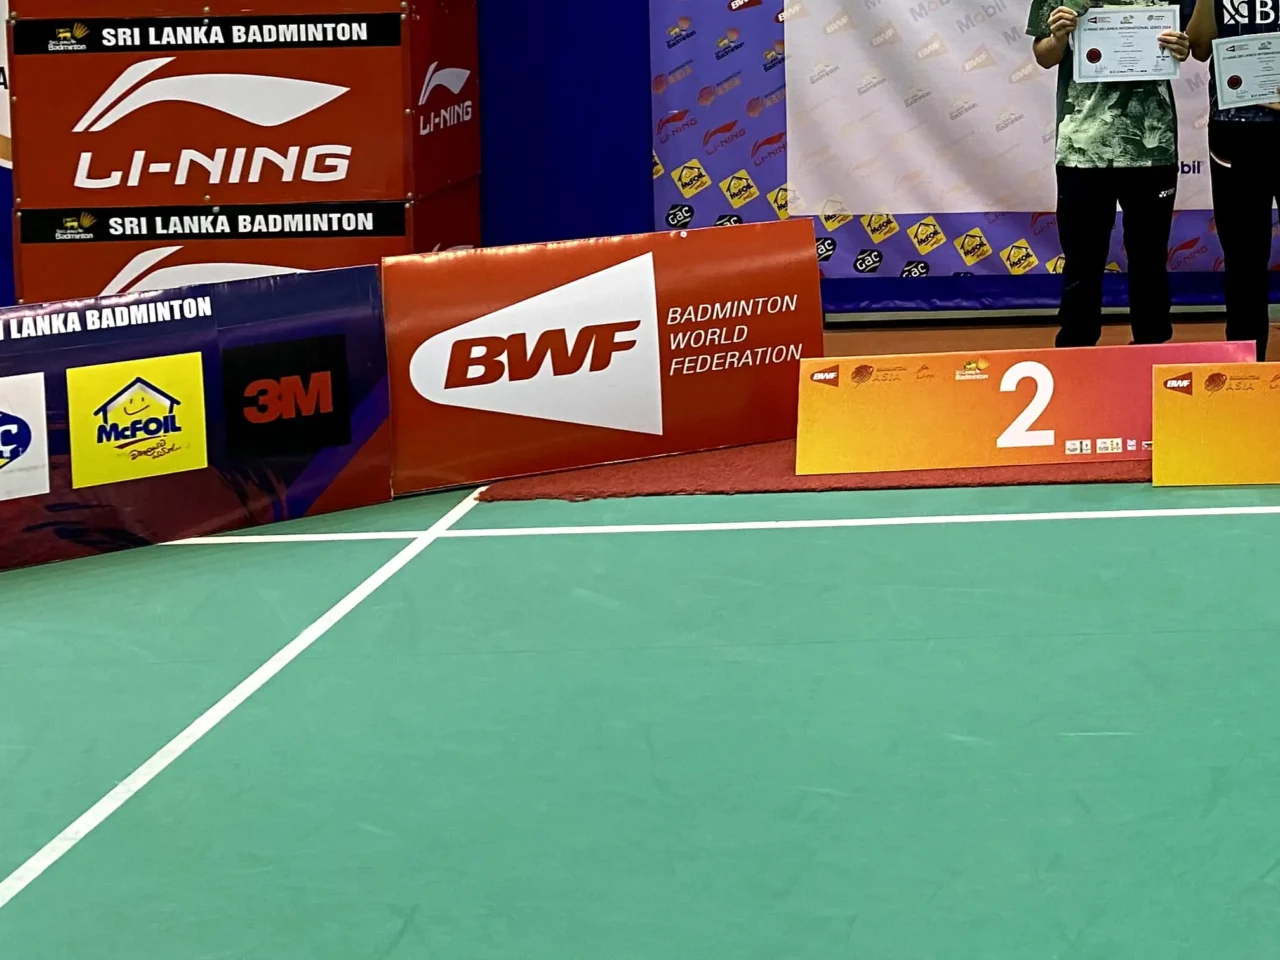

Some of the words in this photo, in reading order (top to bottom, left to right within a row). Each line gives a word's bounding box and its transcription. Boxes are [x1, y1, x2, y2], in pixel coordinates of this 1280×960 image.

[102, 27, 141, 47] SRI
[149, 25, 224, 45] LANKA
[232, 23, 367, 43] BADMINTON
[419, 100, 472, 136] LI-NING
[74, 144, 352, 189] LI-NING
[1180, 160, 1201, 174] bil
[109, 217, 147, 236] SRI
[155, 215, 230, 234] LANKA
[238, 213, 373, 232] BADMINTON
[10, 311, 81, 339] LANKA
[86, 296, 212, 330] BADMINTON
[667, 294, 797, 326] BADMINTON
[669, 326, 748, 351] WORLD
[443, 320, 641, 390] BWF
[669, 344, 802, 376] FEDERATION
[813, 372, 838, 381] BWF
[1166, 380, 1190, 388] BWF
[243, 371, 333, 424] 3M
[997, 361, 1055, 448] 2
